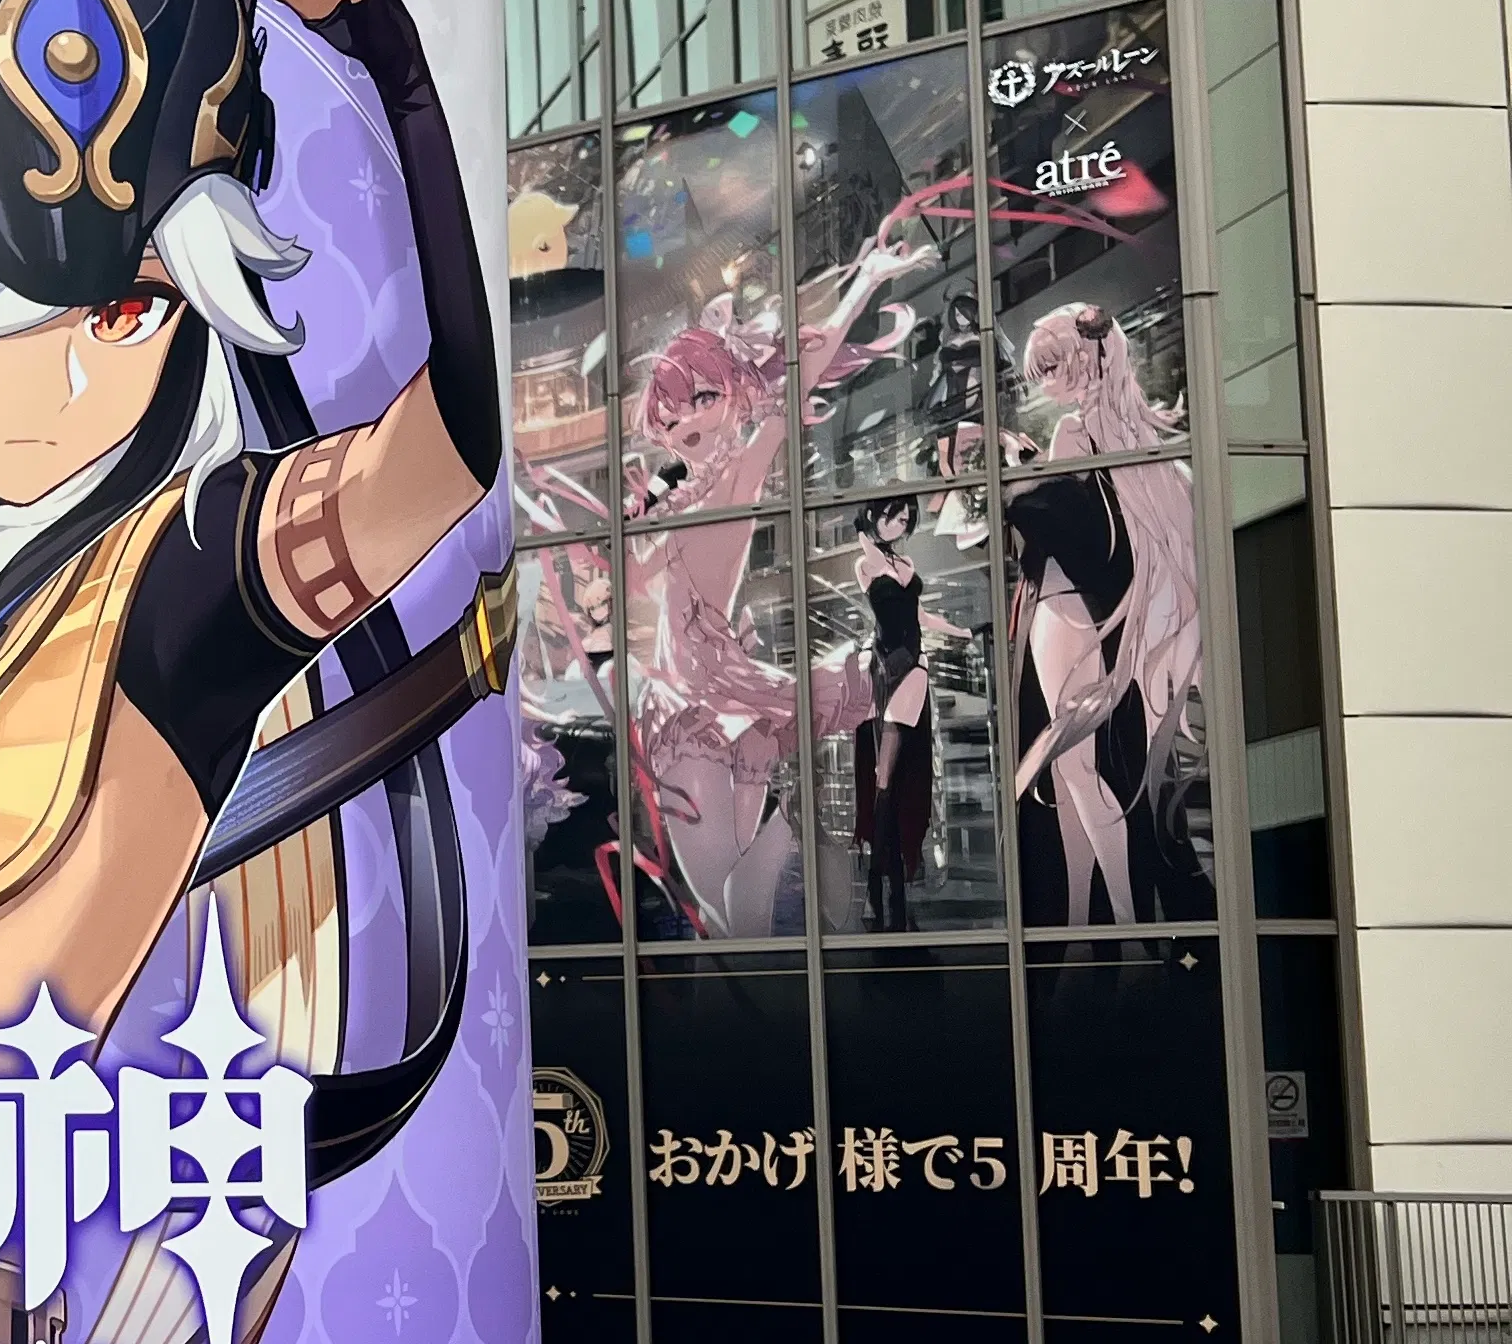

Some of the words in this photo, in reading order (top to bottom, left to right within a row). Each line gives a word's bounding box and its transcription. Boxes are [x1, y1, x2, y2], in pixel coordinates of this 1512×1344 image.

[1041, 47, 1160, 95] アズールレーン
[1035, 140, 1122, 190] atré
[536, 1185, 589, 1197] VERSARY
